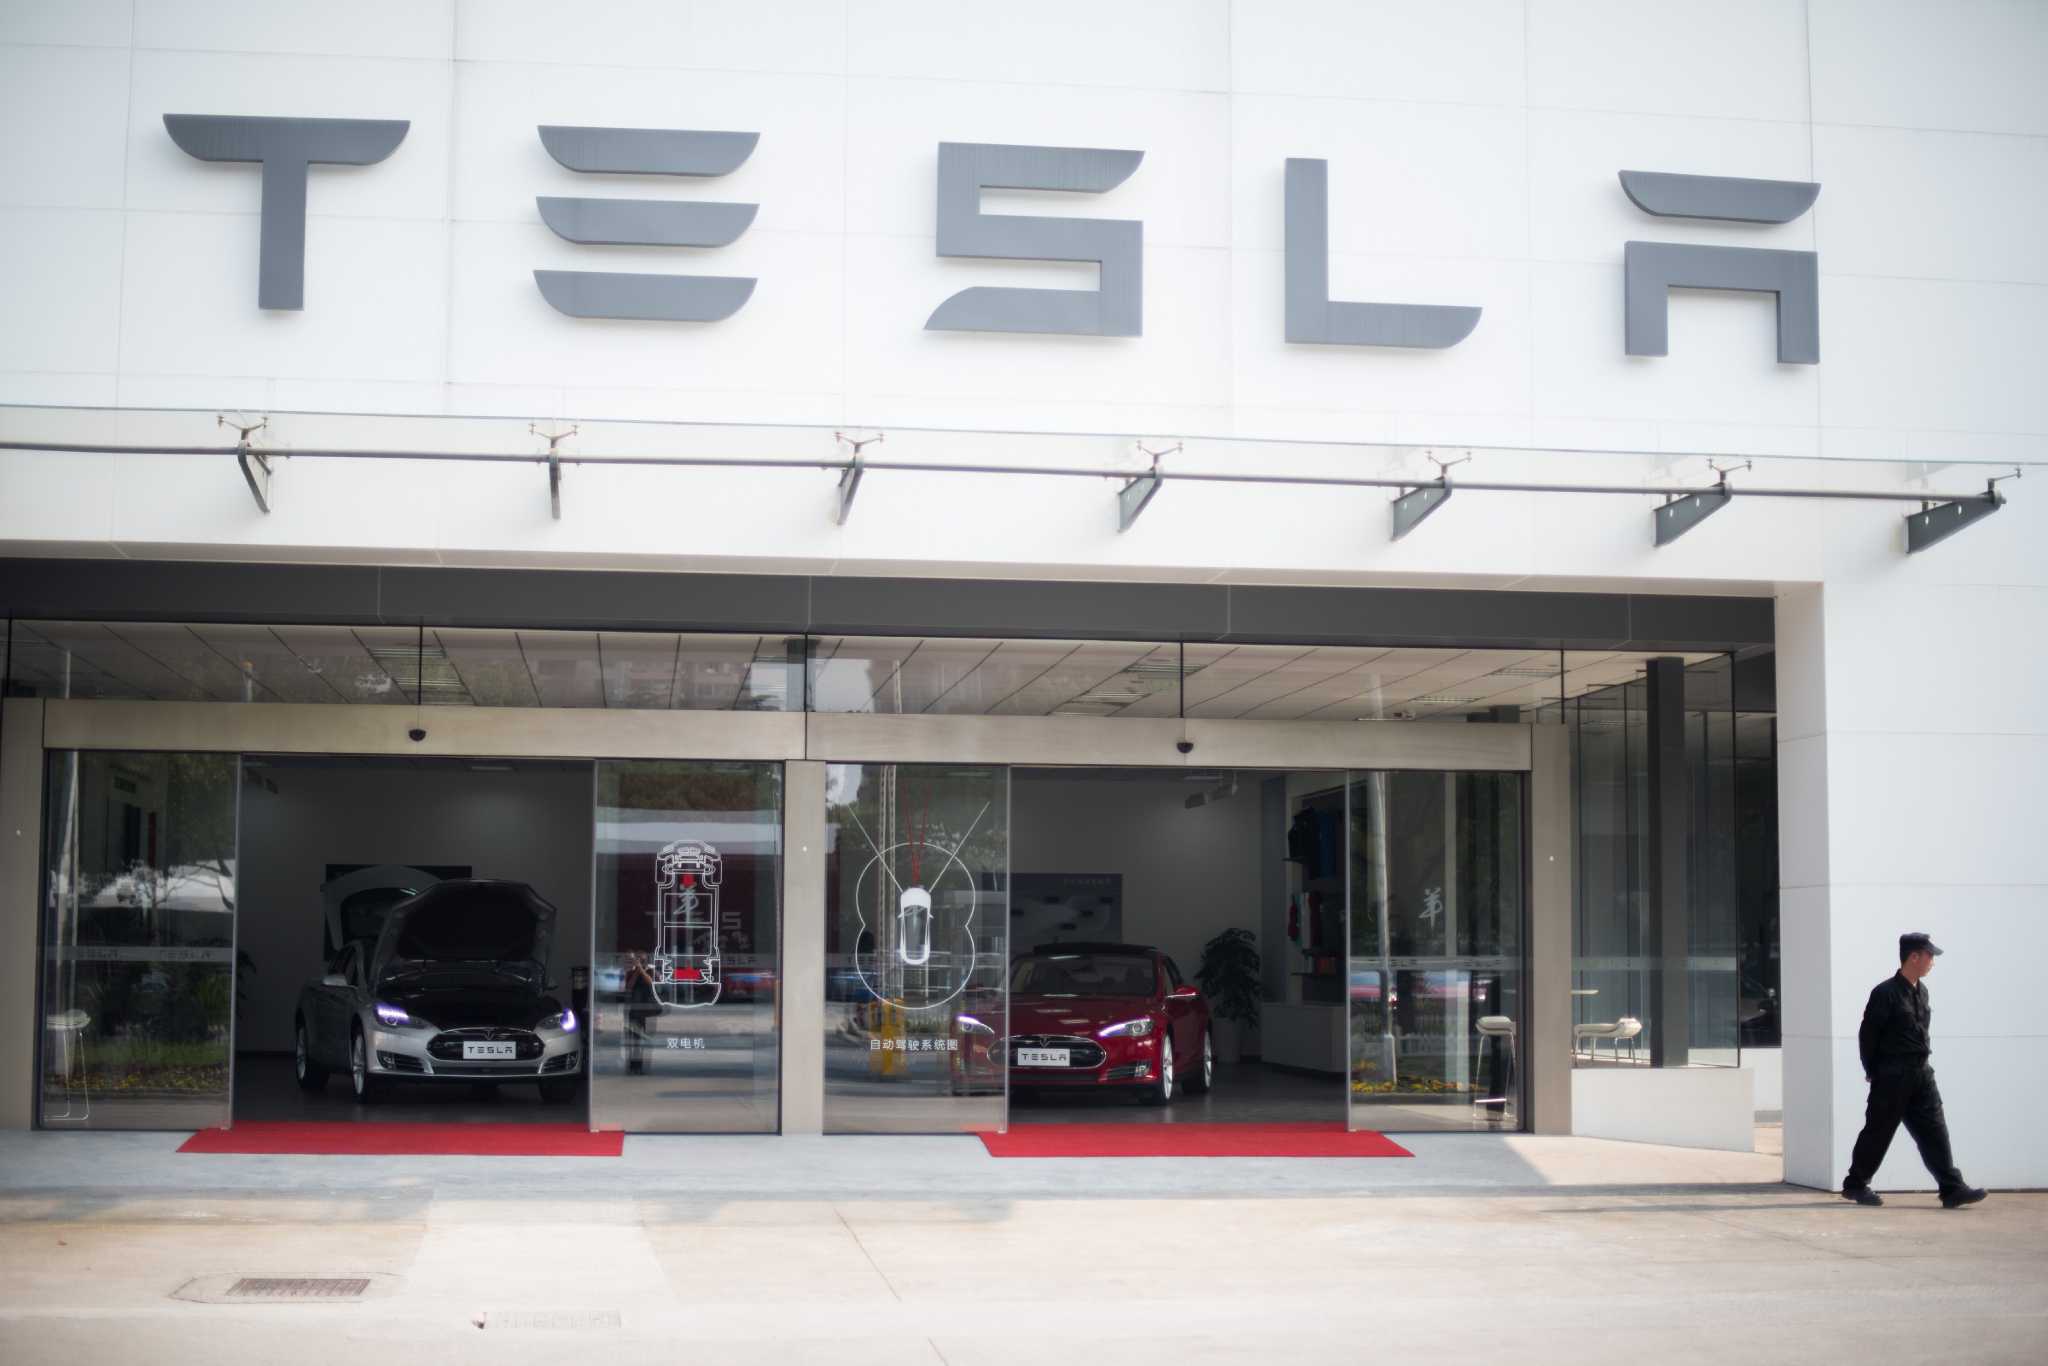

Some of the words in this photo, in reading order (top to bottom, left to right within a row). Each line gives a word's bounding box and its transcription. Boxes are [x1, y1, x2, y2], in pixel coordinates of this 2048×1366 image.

[163, 114, 1820, 366] TESLA
[666, 1037, 705, 1049] 双电机
[869, 1039, 958, 1051] 自动驾驶系统图
[467, 1046, 513, 1054] TESLA
[1021, 1053, 1067, 1061] TESLA
